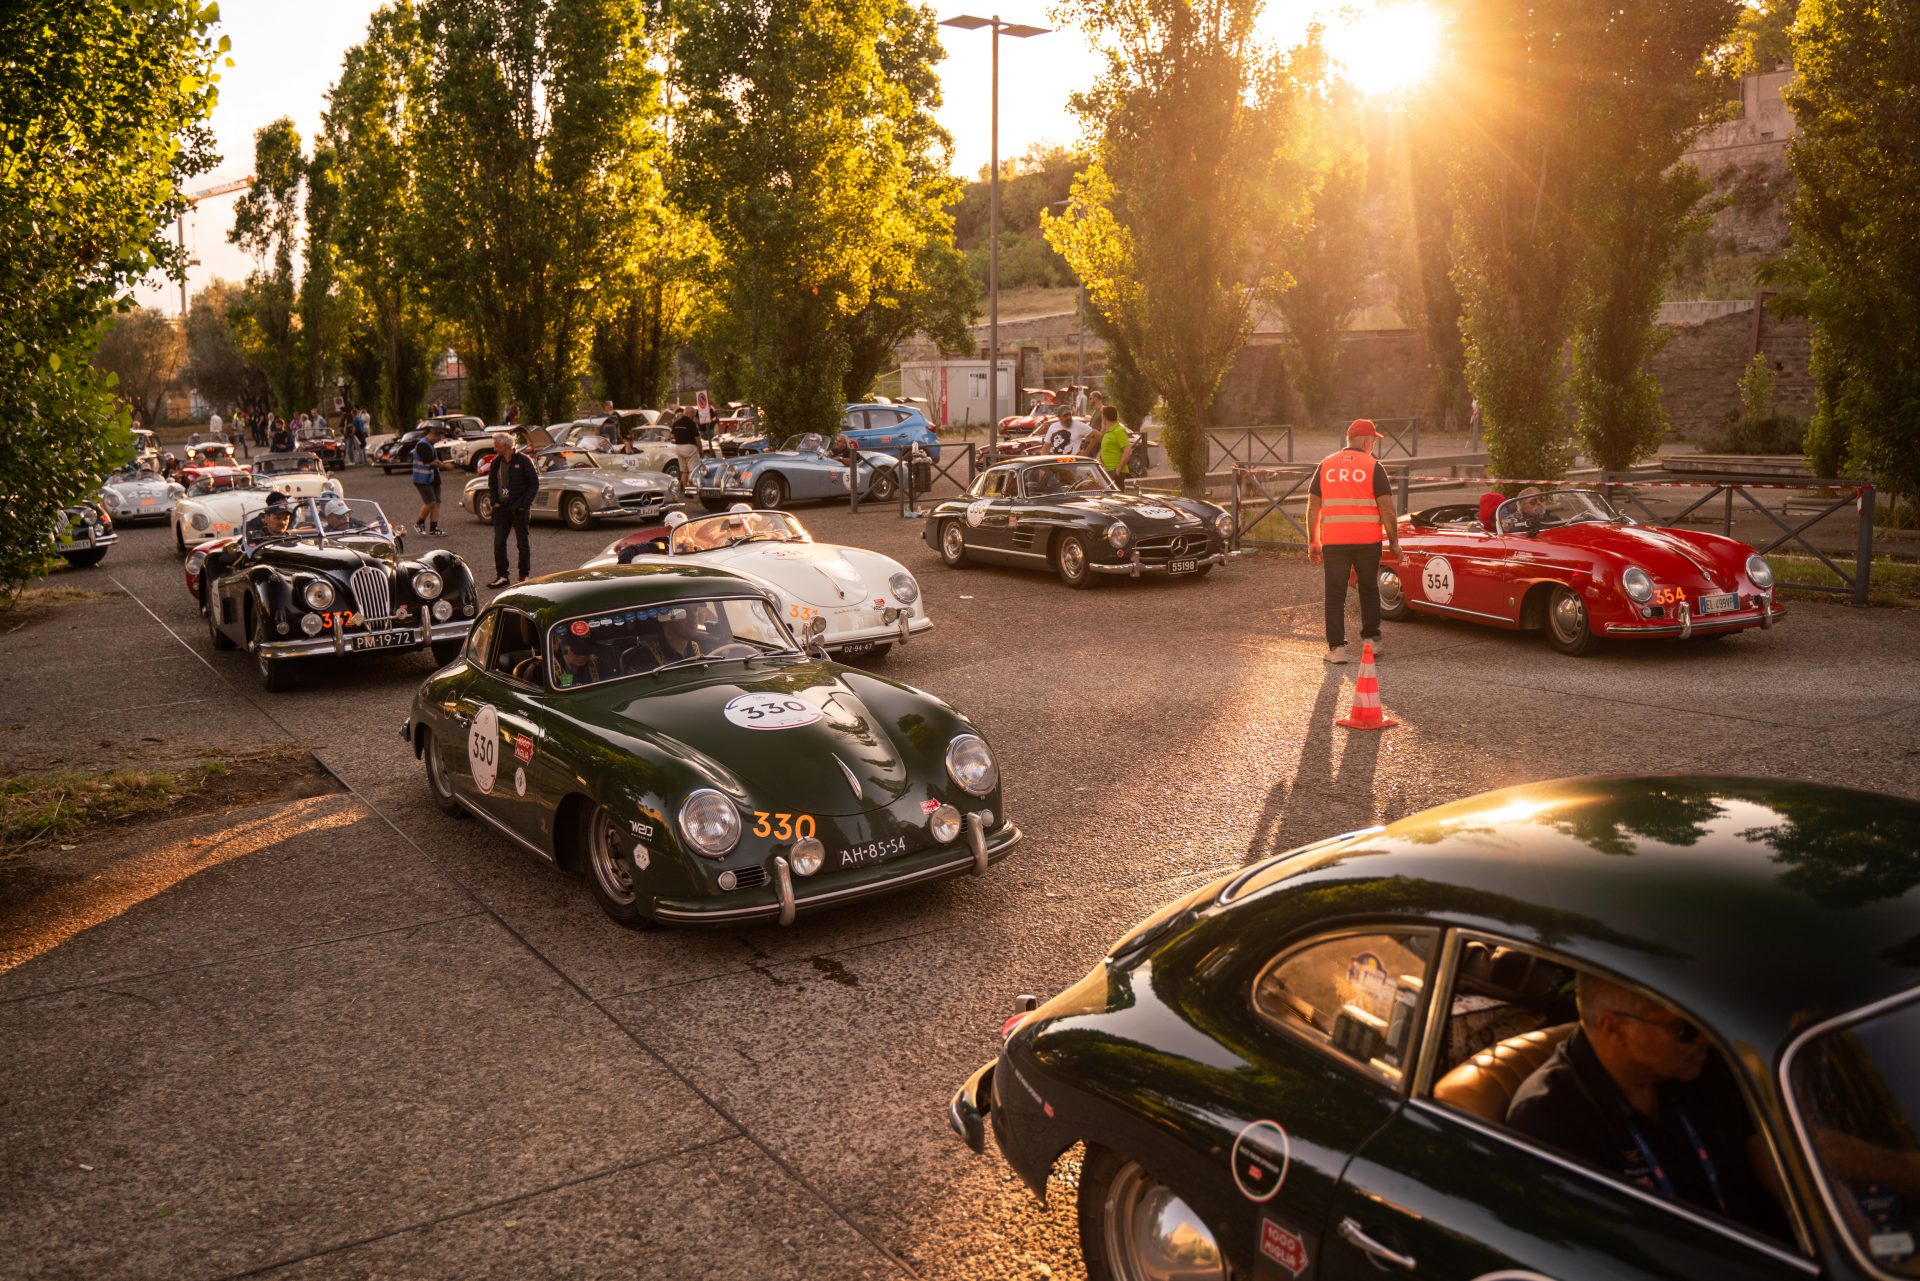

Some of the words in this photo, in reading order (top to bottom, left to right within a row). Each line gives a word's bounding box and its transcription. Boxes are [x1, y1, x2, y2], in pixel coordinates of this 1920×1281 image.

[1325, 468, 1367, 483] CRO
[1172, 561, 1195, 572] 55198
[1427, 573, 1449, 590] 354
[1654, 586, 1686, 605] 354
[740, 701, 806, 719] 330
[473, 732, 494, 766] 330
[752, 810, 816, 841] 330
[841, 837, 907, 866] AH-85-54
[1267, 1227, 1296, 1250] 1000
[1263, 1241, 1298, 1268] MIGLIA
